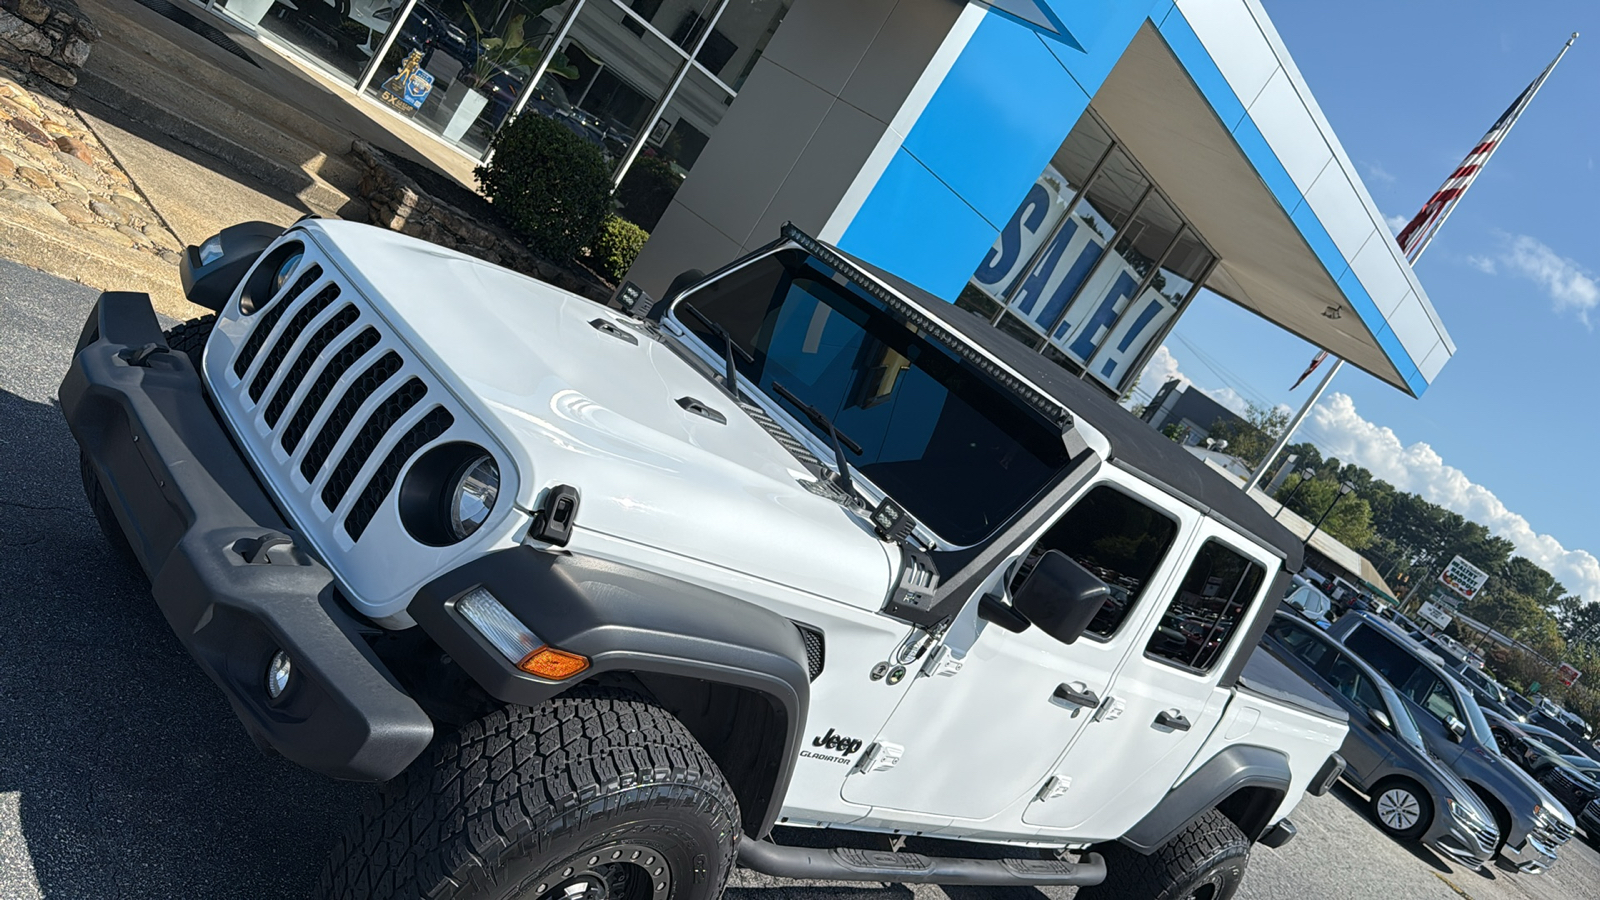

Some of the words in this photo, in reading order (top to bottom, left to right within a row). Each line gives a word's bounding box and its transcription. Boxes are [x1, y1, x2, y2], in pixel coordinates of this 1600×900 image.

[381, 91, 398, 105] 5X
[973, 183, 1164, 379] SALE!
[1450, 567, 1478, 587] HARVEST
[1451, 561, 1478, 579] HEALTHY
[812, 727, 863, 756] Jeep
[799, 750, 851, 765] GLADIATOR
